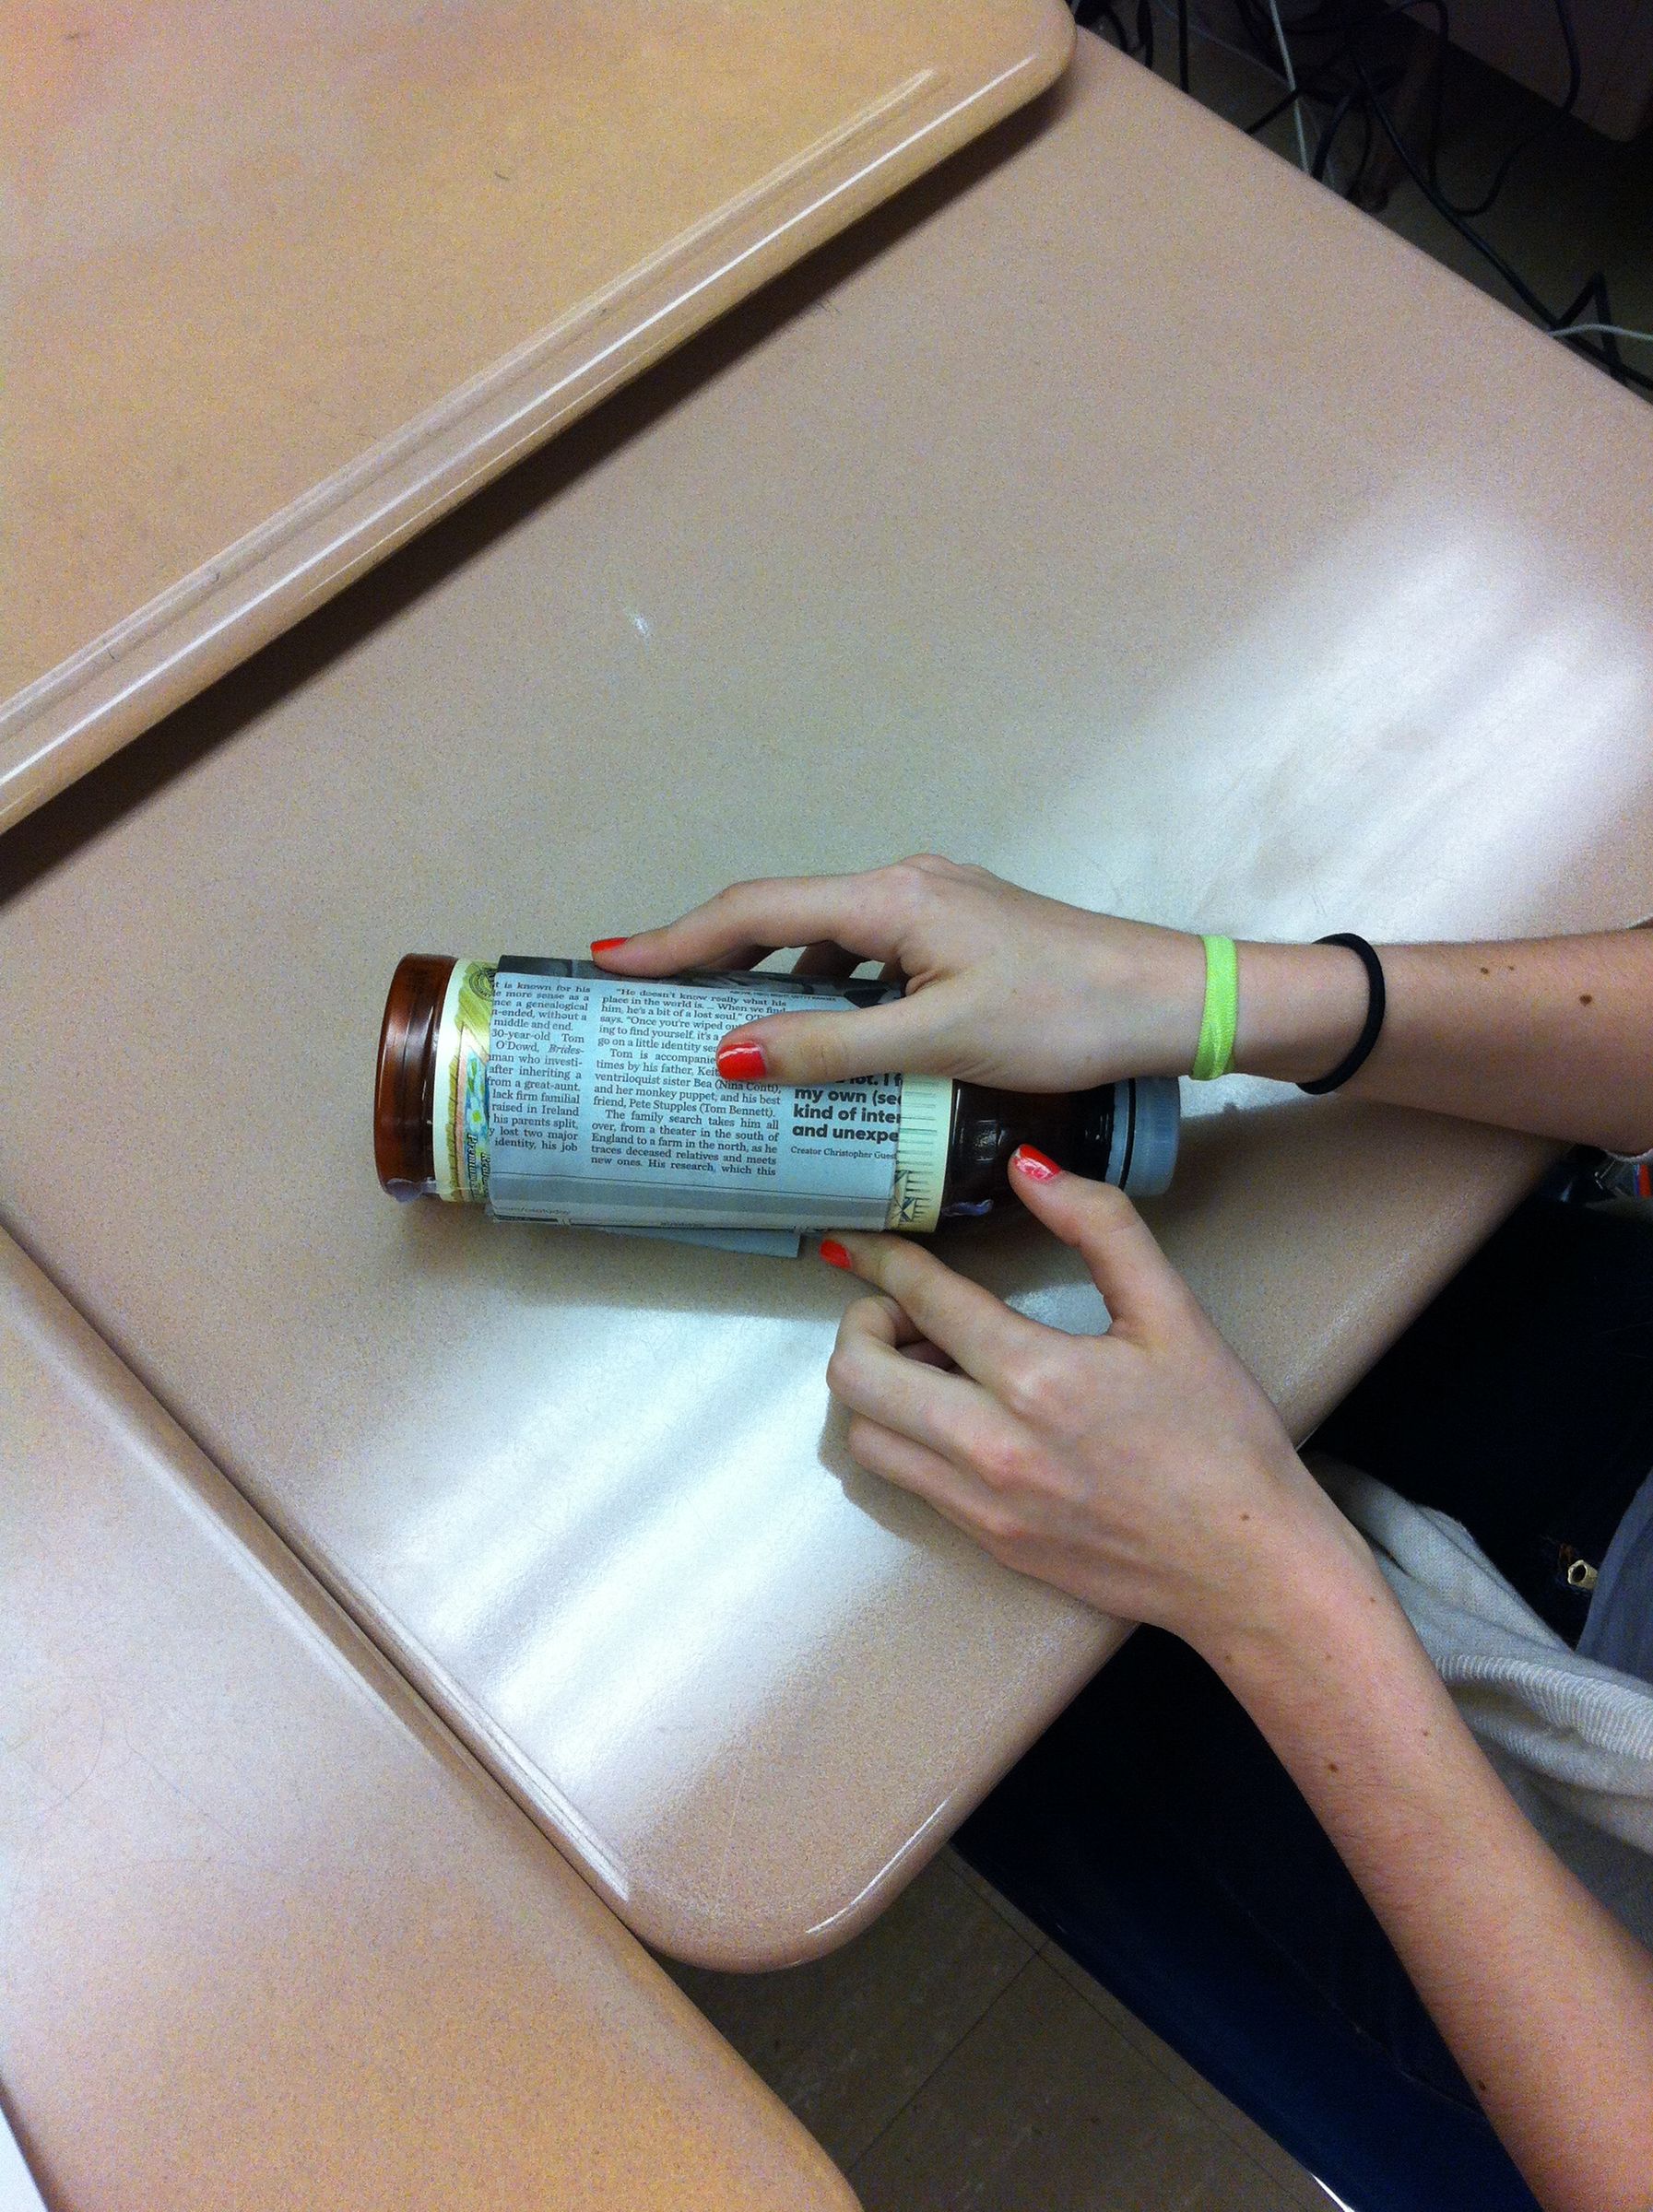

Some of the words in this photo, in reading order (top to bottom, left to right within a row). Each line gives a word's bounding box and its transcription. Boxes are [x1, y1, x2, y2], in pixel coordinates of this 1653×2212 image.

[525, 1001, 588, 1011] genealogical
[602, 995, 629, 1004] place
[631, 996, 642, 1005] in
[644, 997, 660, 1006] the
[663, 1000, 691, 1008] world
[718, 1003, 747, 1012] When
[712, 996, 739, 1005] really
[743, 997, 767, 1006] what
[538, 1011, 579, 1021] without
[656, 1007, 670, 1016] bit
[693, 1010, 713, 1018] lost
[493, 1018, 529, 1028] middle
[531, 1020, 550, 1030] and
[552, 1022, 573, 1031] end.
[599, 1025, 615, 1036] ing
[618, 1026, 628, 1035] to
[630, 1026, 650, 1037] find
[693, 1020, 723, 1030] wiped
[561, 1033, 585, 1043] Tom
[597, 1038, 610, 1047] go
[635, 1038, 659, 1049] little
[661, 1041, 702, 1053] identity
[519, 1054, 540, 1065] who
[545, 1055, 583, 1067] investi-
[609, 1048, 633, 1059] Tom
[640, 1050, 649, 1059] is
[490, 1065, 514, 1075] after
[519, 1065, 571, 1080] inheriting
[596, 1059, 625, 1070] times
[628, 1061, 641, 1073] by
[643, 1062, 658, 1072] his
[487, 1077, 512, 1087] from
[595, 1073, 661, 1086] ventriloquist
[663, 1077, 691, 1087] sister
[694, 1078, 712, 1088] Bea
[492, 1089, 514, 1100] lack
[516, 1090, 538, 1101] firm
[541, 1092, 580, 1104] familial
[594, 1084, 613, 1094] and
[616, 1085, 633, 1095] her
[635, 1088, 678, 1100] monkey
[679, 1091, 717, 1102] puppet,
[720, 1093, 739, 1103] and
[742, 1093, 757, 1103] his
[760, 1094, 781, 1105] best
[795, 1088, 824, 1104] my
[827, 1090, 867, 1104] own
[491, 1102, 523, 1112] raised
[527, 1104, 537, 1113] in
[542, 1105, 579, 1116] Ireland
[593, 1096, 627, 1108] friend,
[630, 1099, 651, 1110] Pete
[653, 1100, 697, 1113] Stupples
[700, 1102, 726, 1114] (Tom
[793, 1103, 833, 1121] kind
[837, 1107, 857, 1122] of
[493, 1113, 509, 1124] his
[512, 1117, 550, 1127] parents
[605, 1109, 626, 1120] The
[631, 1111, 664, 1124] family
[669, 1114, 702, 1125] search
[708, 1116, 736, 1127] takes
[741, 1118, 761, 1128] him
[766, 1119, 779, 1130] all
[501, 1125, 519, 1136] lost
[524, 1129, 543, 1138] two
[548, 1131, 579, 1141] major
[591, 1123, 617, 1132] over,
[620, 1122, 645, 1134] from
[659, 1125, 697, 1136] theater
[701, 1127, 711, 1137] in
[714, 1129, 732, 1139] the
[736, 1131, 764, 1141] south
[768, 1133, 780, 1142] of
[792, 1124, 828, 1139] and
[494, 1136, 537, 1150] identity,
[542, 1140, 557, 1150] his
[561, 1141, 578, 1153] job
[591, 1132, 634, 1145] England
[637, 1136, 647, 1146] to
[658, 1136, 683, 1148] farm
[685, 1138, 695, 1148] in
[699, 1139, 715, 1150] the
[718, 1142, 750, 1153] north,
[764, 1144, 778, 1154] he
[591, 1145, 621, 1156] traces
[626, 1147, 672, 1159] deceased
[676, 1149, 719, 1161] relatives
[723, 1154, 742, 1163] and
[746, 1156, 776, 1165] meets
[790, 1146, 822, 1156] Creator
[823, 1147, 873, 1159] Christopher
[591, 1157, 612, 1165] new
[648, 1159, 666, 1169] His
[722, 1164, 752, 1175] which
[757, 1167, 776, 1176] this
